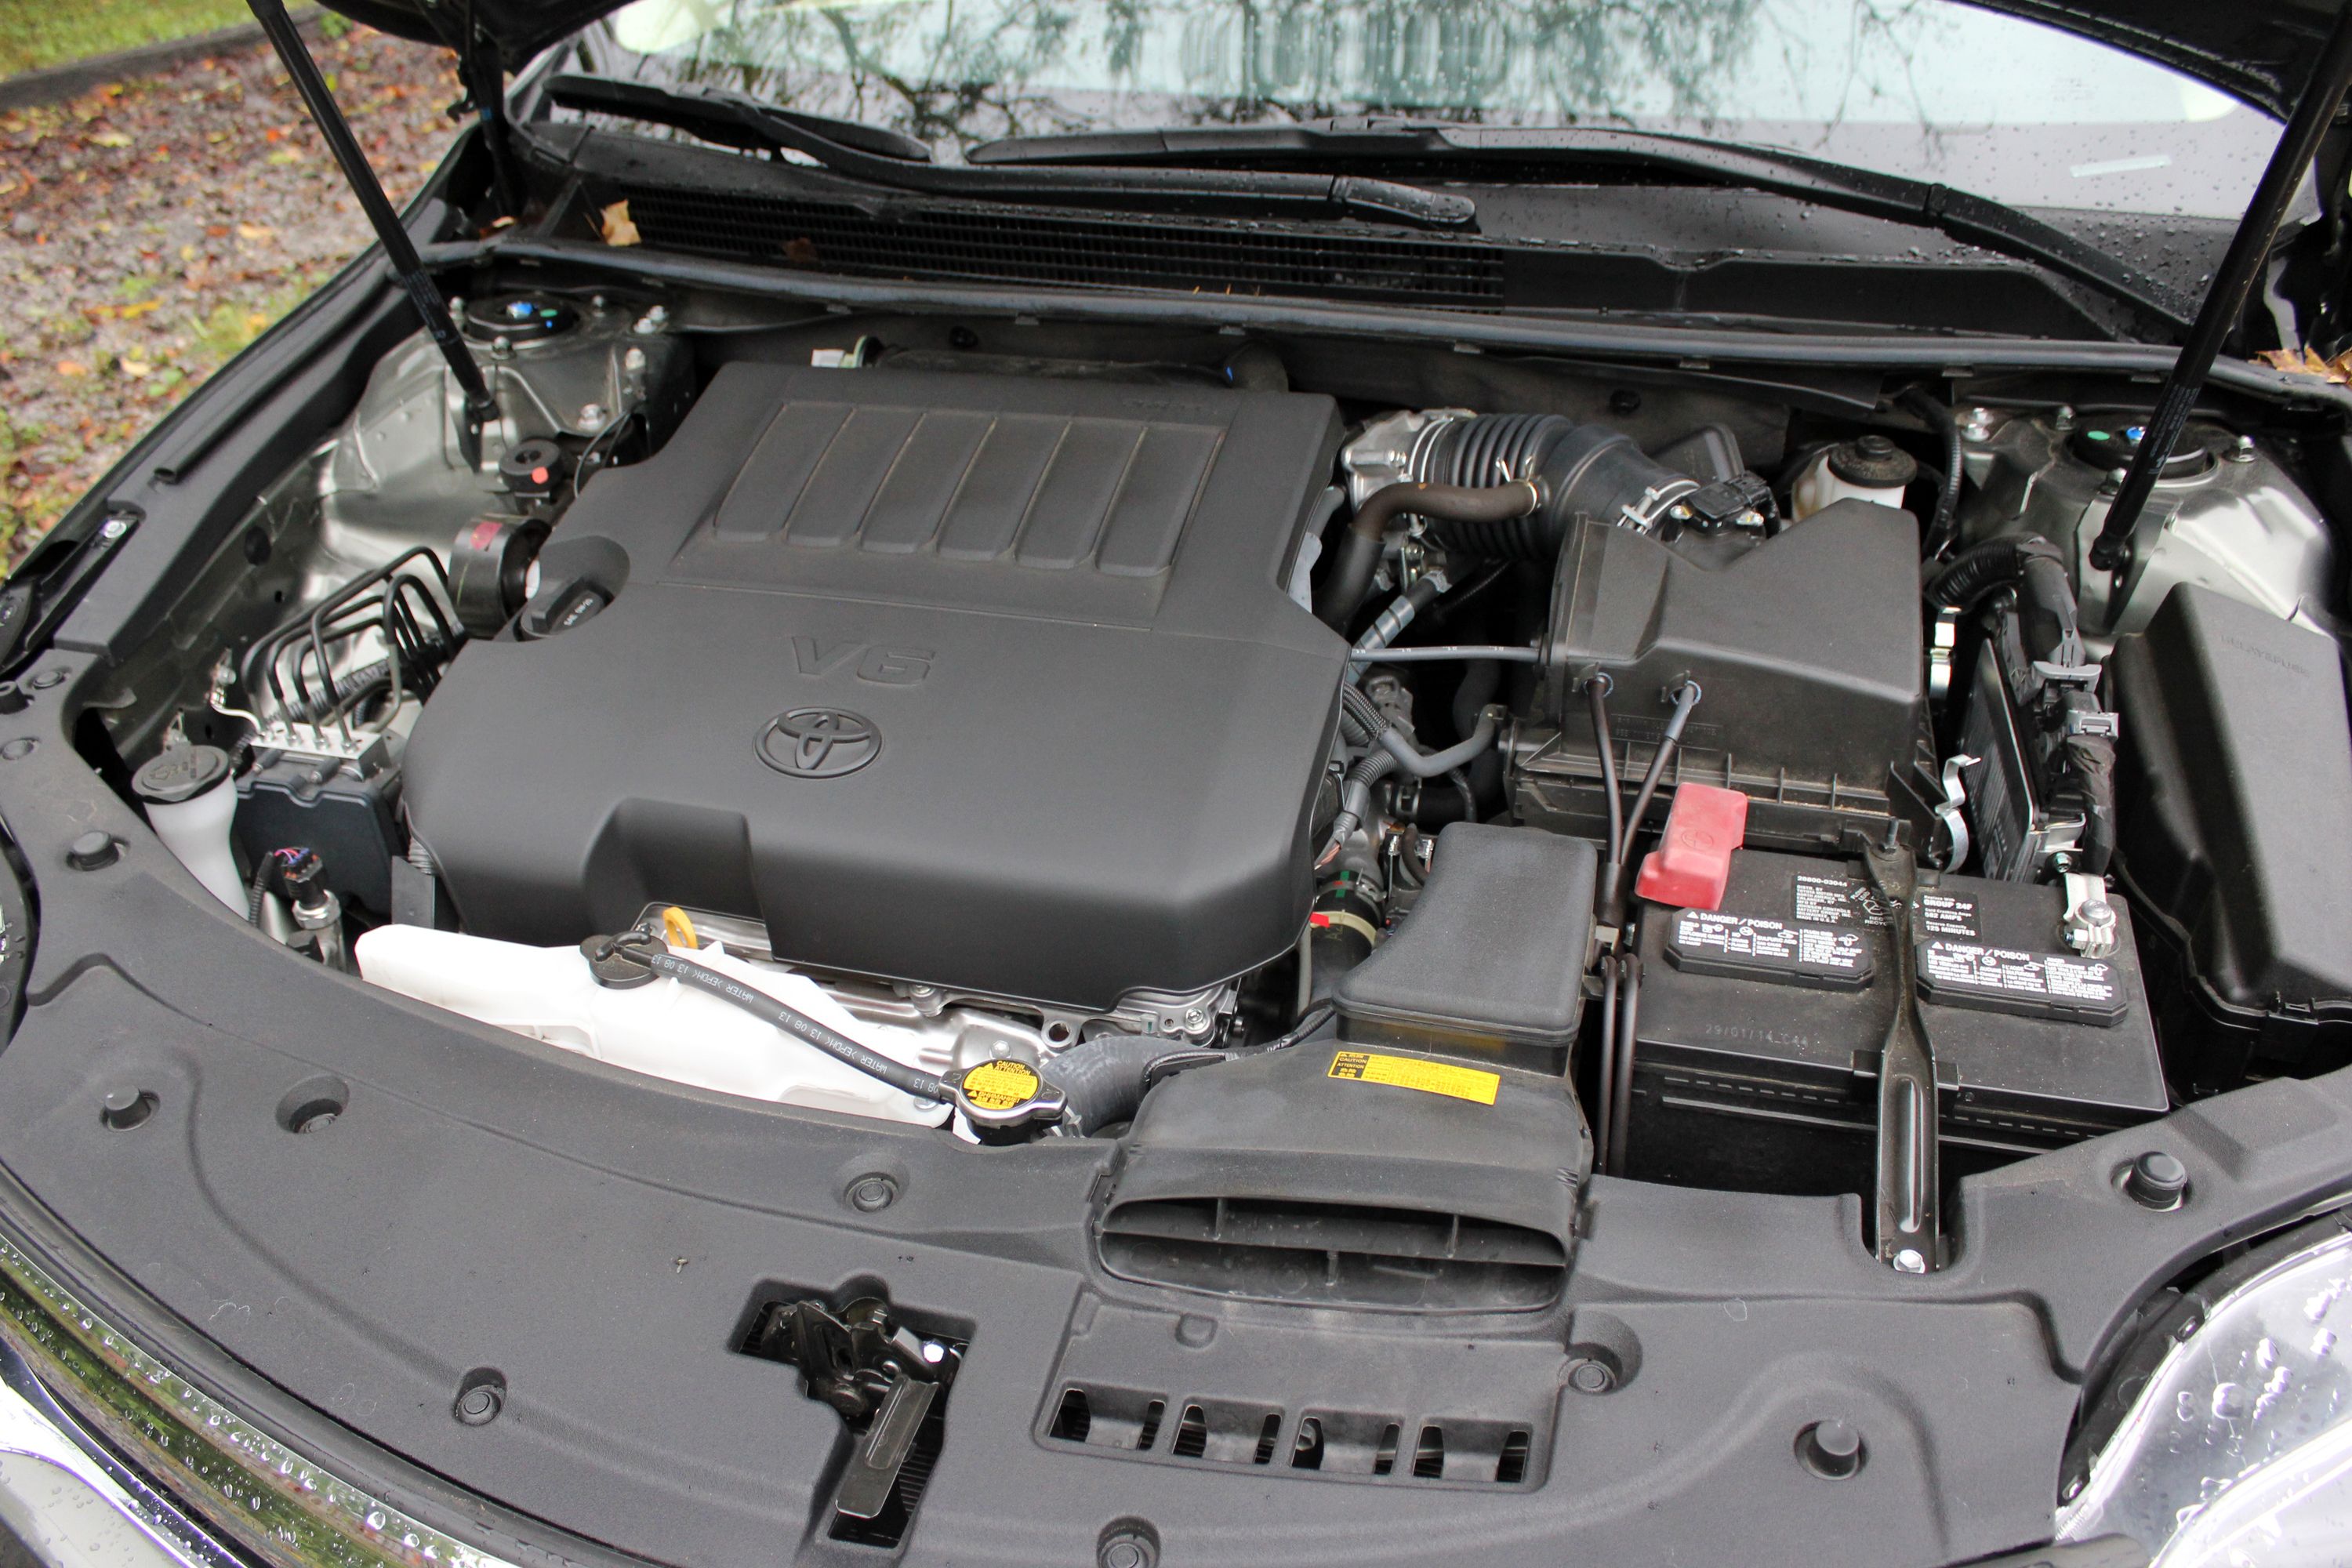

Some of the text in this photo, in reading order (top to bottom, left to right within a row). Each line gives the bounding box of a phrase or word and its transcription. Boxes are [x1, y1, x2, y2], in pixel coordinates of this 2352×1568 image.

[792, 636, 936, 687] V6
[1797, 876, 1848, 887] 28800-03044
[1923, 899, 1955, 908] GROUP
[1940, 927, 1976, 936] MINUTES
[663, 958, 676, 970] 08
[677, 963, 689, 975] 13
[724, 983, 755, 1004] WATER
[778, 1011, 791, 1022] 13
[793, 1019, 808, 1033] 08
[809, 1028, 822, 1040] 13
[859, 1054, 888, 1075] WATER
[996, 1060, 1025, 1069] CAUTION
[994, 1066, 1031, 1076] ATTENTION
[913, 1079, 924, 1089] 13
